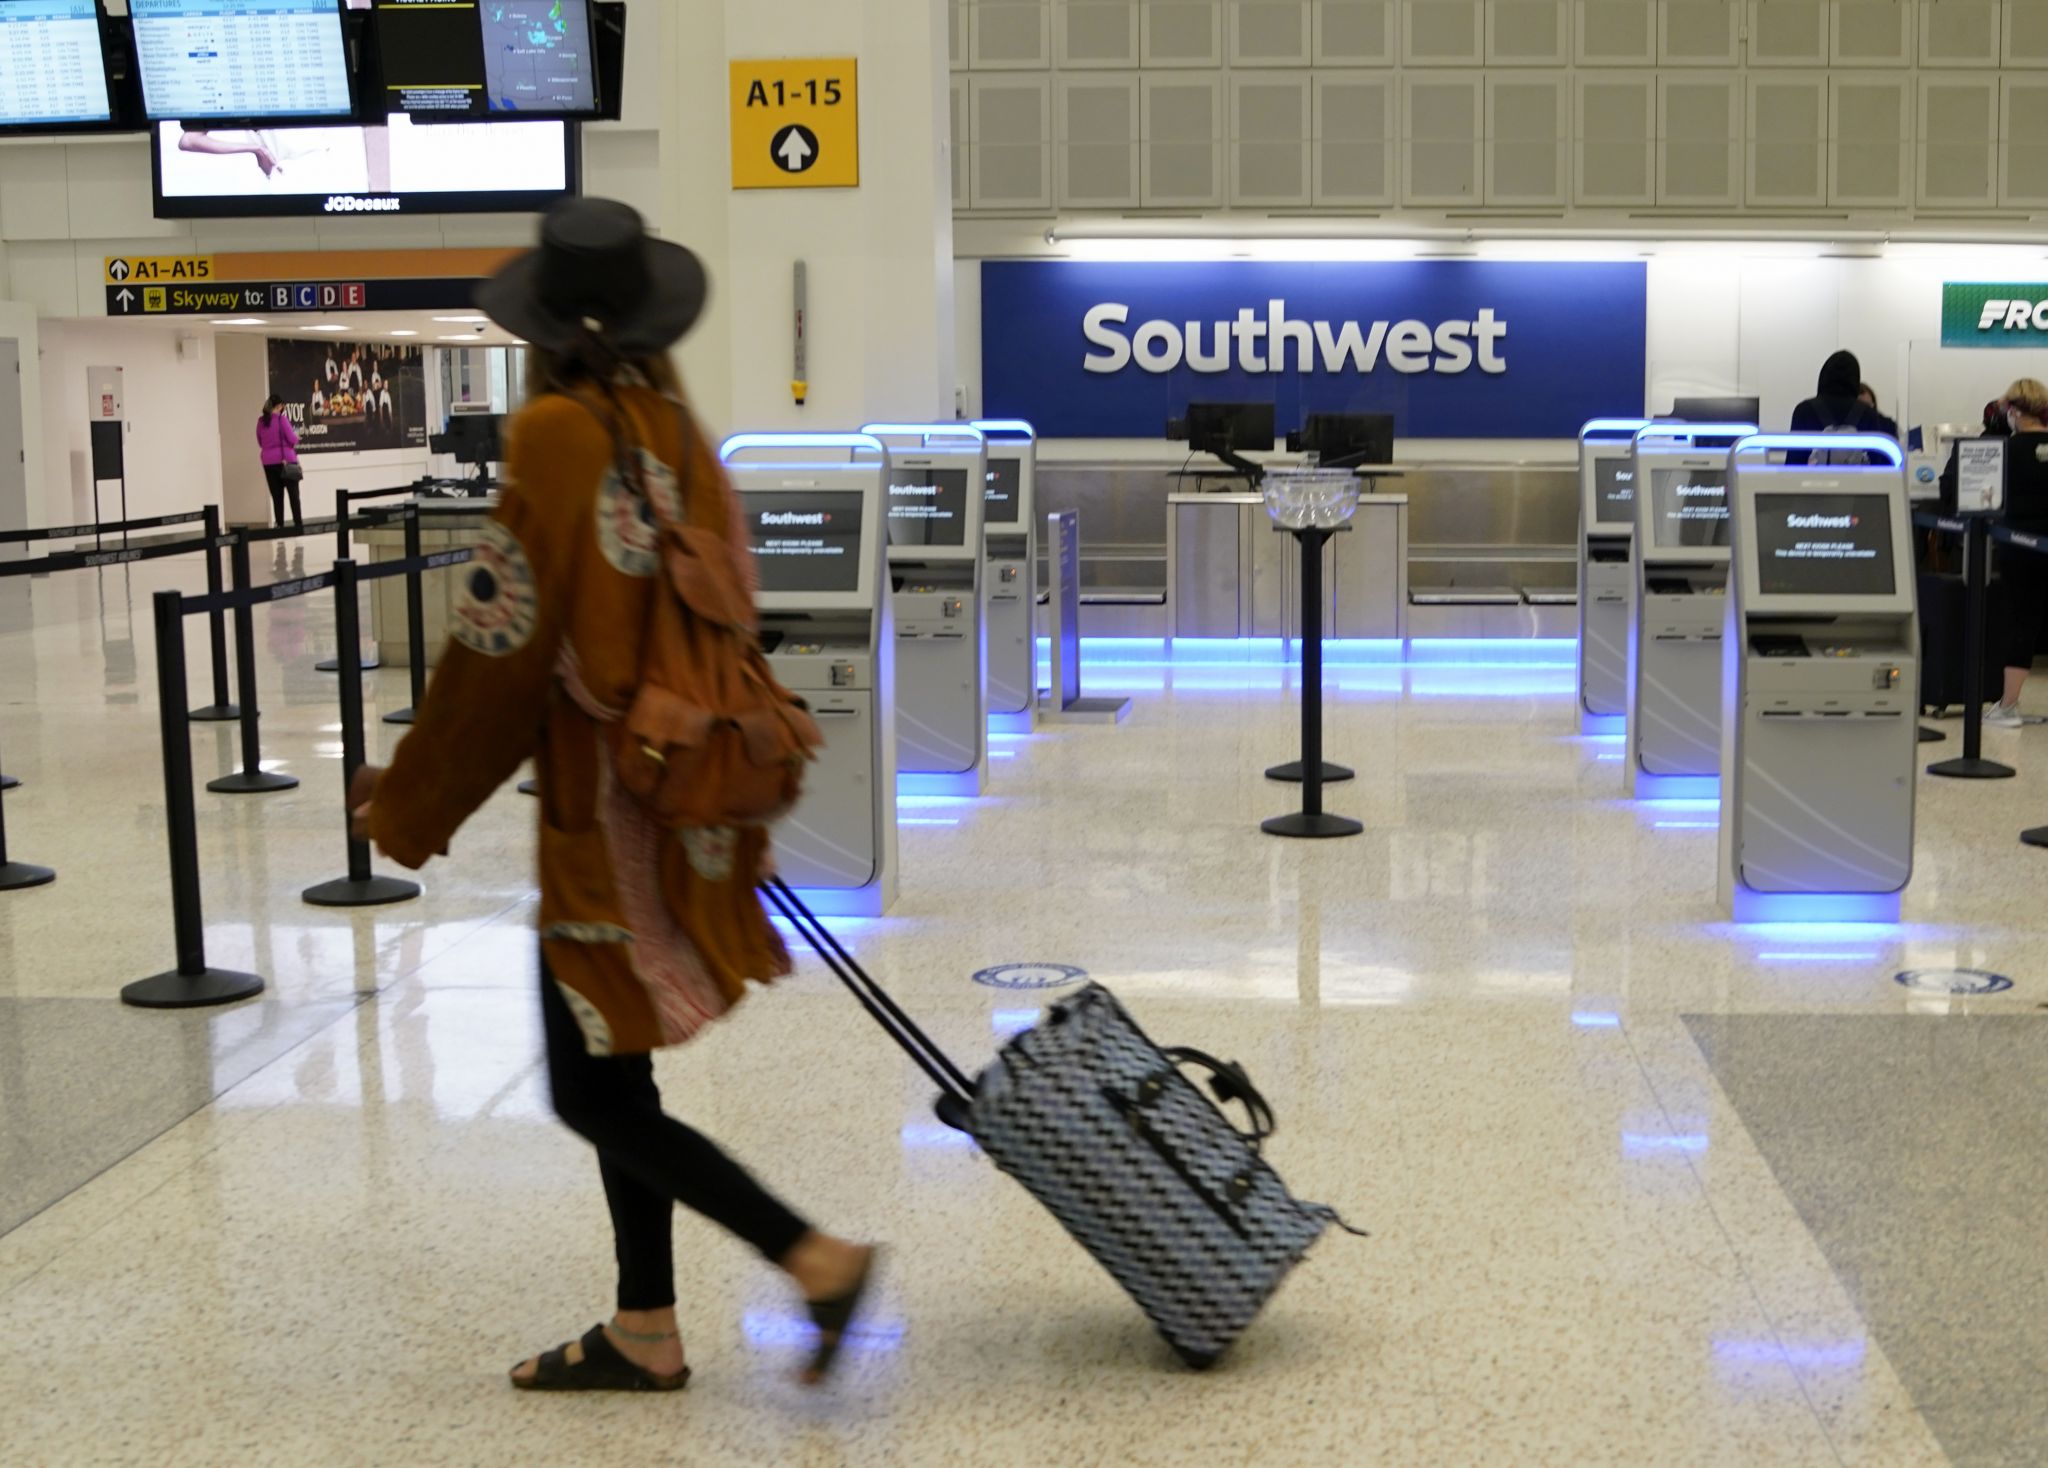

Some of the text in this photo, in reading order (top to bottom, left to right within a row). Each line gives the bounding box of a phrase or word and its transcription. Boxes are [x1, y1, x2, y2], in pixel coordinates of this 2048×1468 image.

[746, 78, 842, 108] A1-15
[323, 195, 400, 212] JCDecaux
[135, 260, 209, 279] A1-A15
[173, 285, 359, 310] Skyway to: B C D E
[1082, 298, 1507, 374] Southwest
[888, 484, 937, 496] Southwest
[1675, 484, 1725, 496] Southwest
[760, 511, 823, 525] Southwest
[1786, 512, 1851, 528] Southwest
